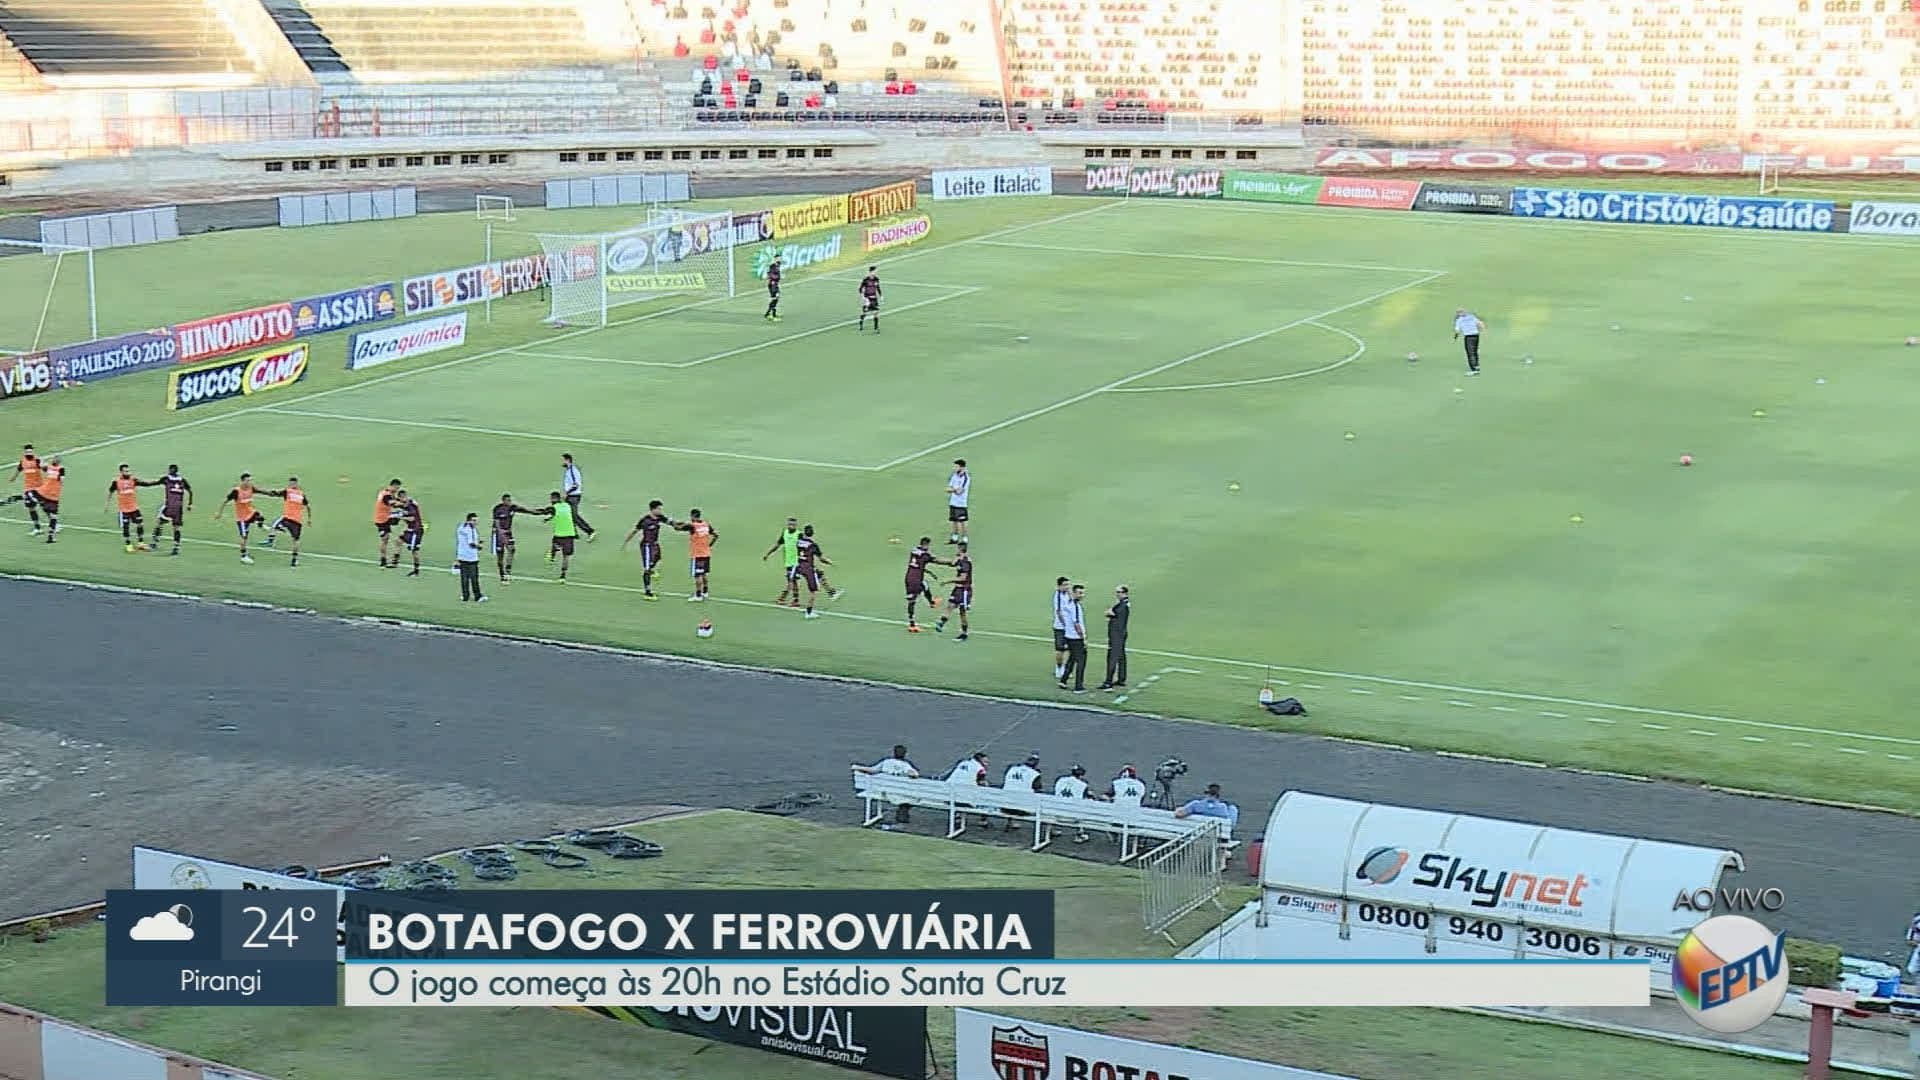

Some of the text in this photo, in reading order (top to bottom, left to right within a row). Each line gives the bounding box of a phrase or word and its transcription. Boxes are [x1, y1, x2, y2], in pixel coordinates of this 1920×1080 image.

[1086, 164, 1129, 190] DOLLY
[1317, 150, 1667, 170] AFOGO
[944, 174, 1041, 197] Leite Italac
[1131, 168, 1175, 194] DOLLY
[1177, 171, 1220, 196] DOLLY
[778, 200, 843, 235] quartzolit
[853, 185, 915, 221] PATRONI
[1544, 190, 1831, 231] São Cristóvão saúde
[1853, 205, 1920, 228] Bora
[871, 219, 928, 246] DADINHO
[782, 233, 841, 270] Sicredi
[406, 267, 482, 312] Sil Sil
[503, 248, 574, 296] FERRACINI
[609, 275, 700, 290] quartzolit
[319, 291, 373, 329] ASSAÍ
[179, 309, 292, 358] HINOMOTO
[356, 321, 461, 360] Boraquímica
[71, 339, 176, 378] PAULISTÃO 2019
[180, 350, 304, 404] SUCOS CAMP
[1413, 852, 1589, 908] Skynet
[1291, 897, 1338, 915] Skynet
[1359, 903, 1601, 956] 0800 940 3006
[1643, 946, 1672, 964] Sky
